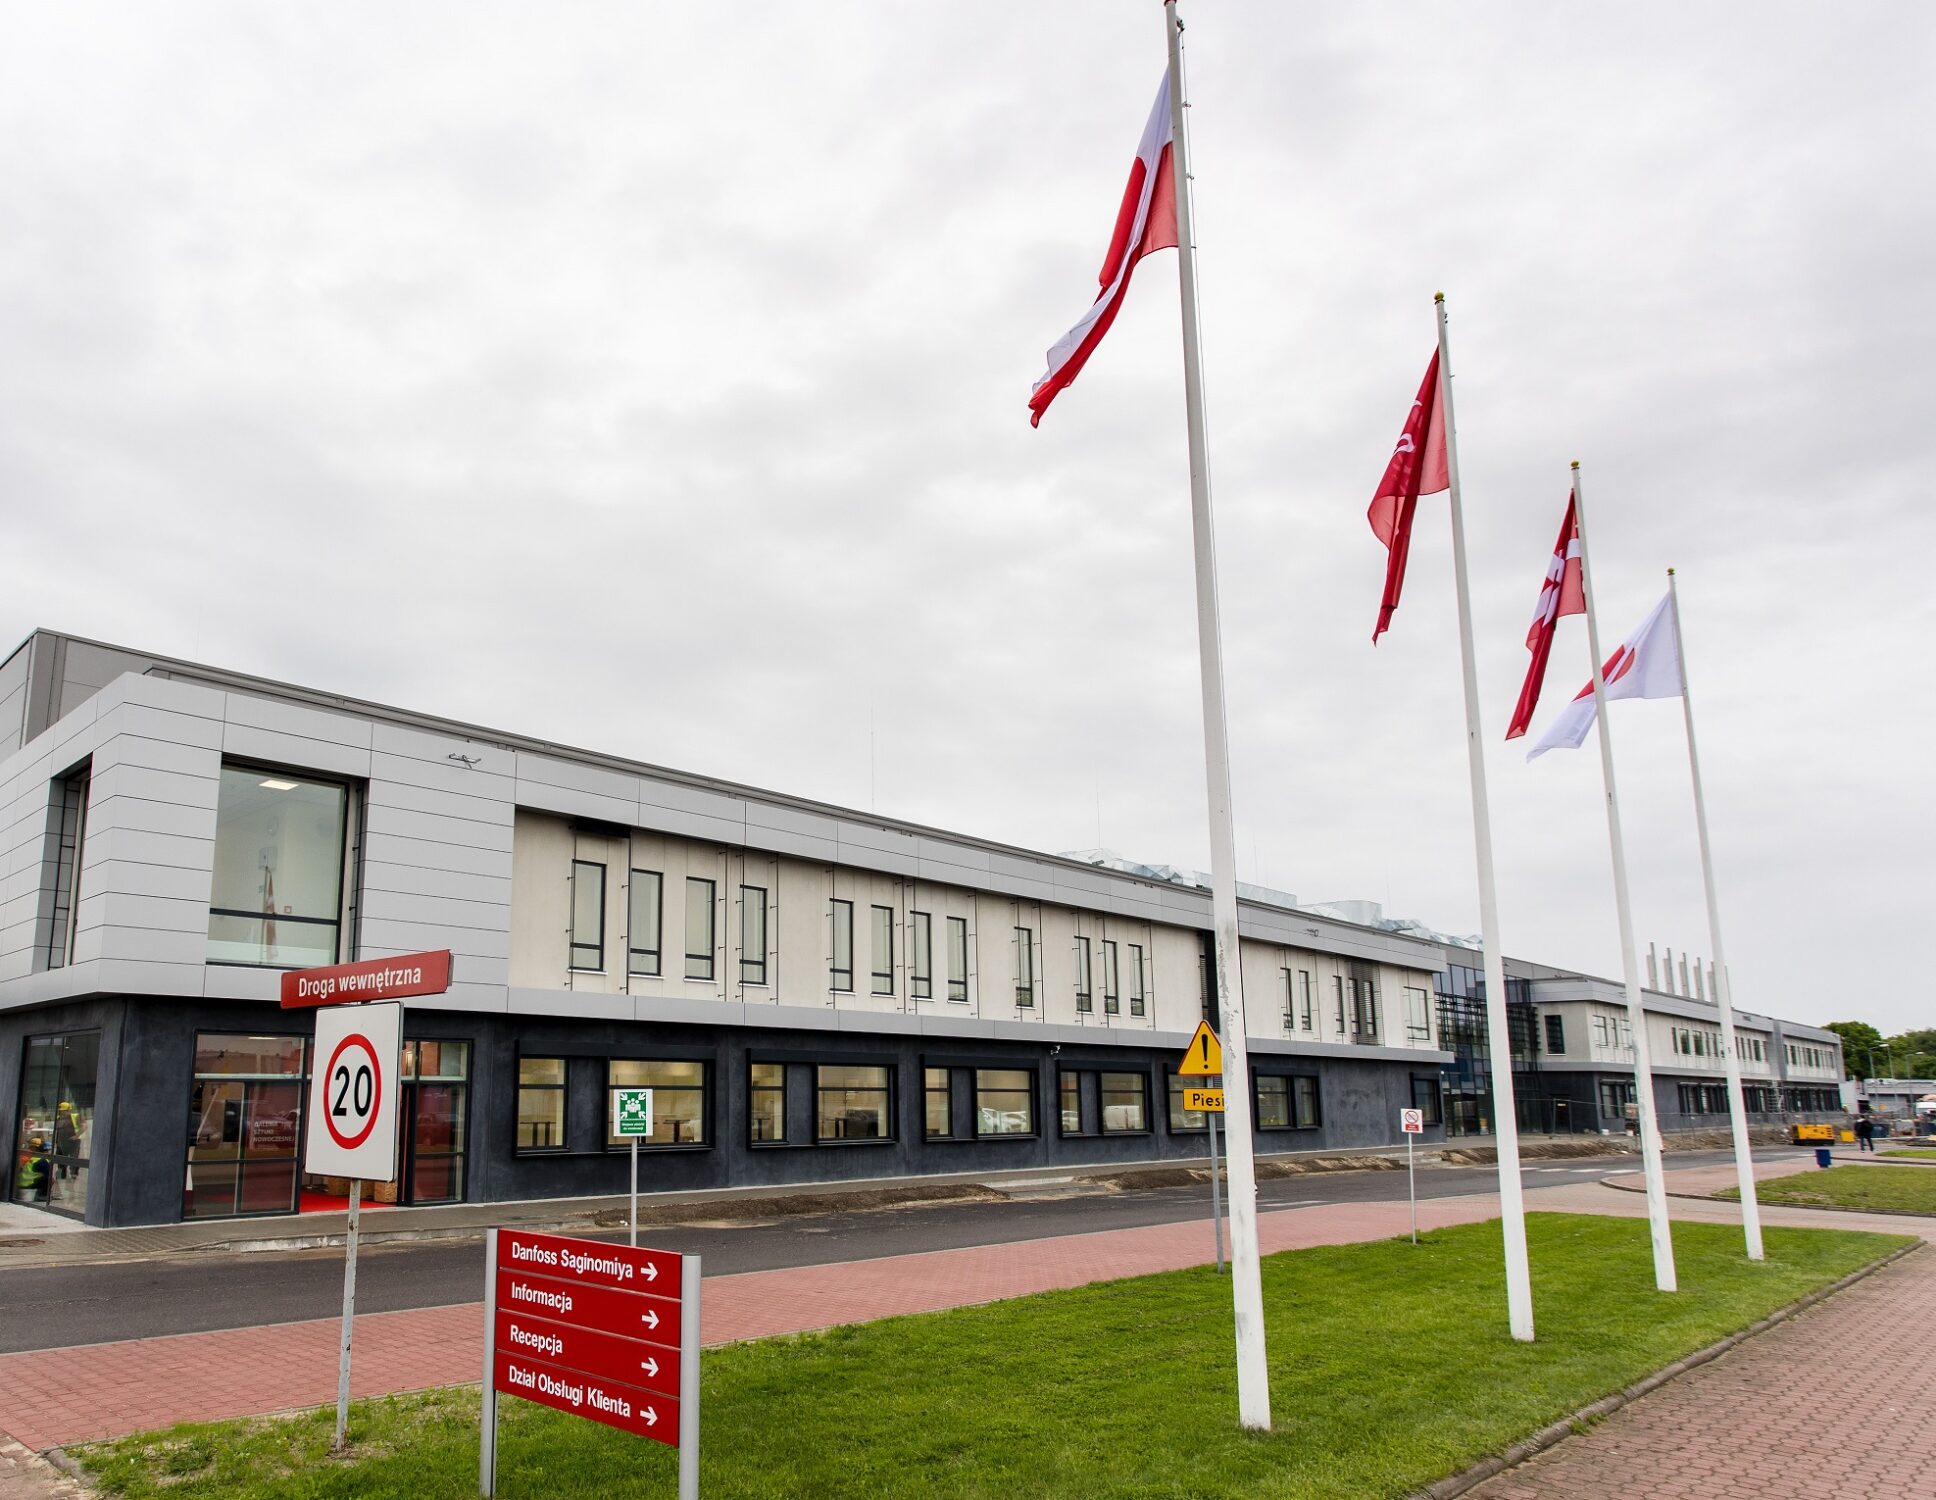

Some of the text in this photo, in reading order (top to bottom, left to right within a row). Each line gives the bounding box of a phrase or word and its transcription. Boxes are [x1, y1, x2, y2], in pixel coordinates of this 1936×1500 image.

[298, 966, 421, 999] Droga wewnętrzna
[332, 1064, 373, 1117] 20
[512, 1242, 633, 1281] Danfoss Saginomiya
[511, 1282, 572, 1313] Informacja
[510, 1324, 563, 1356] Recepcja
[509, 1365, 631, 1418] Dział Obsługi Klienta
